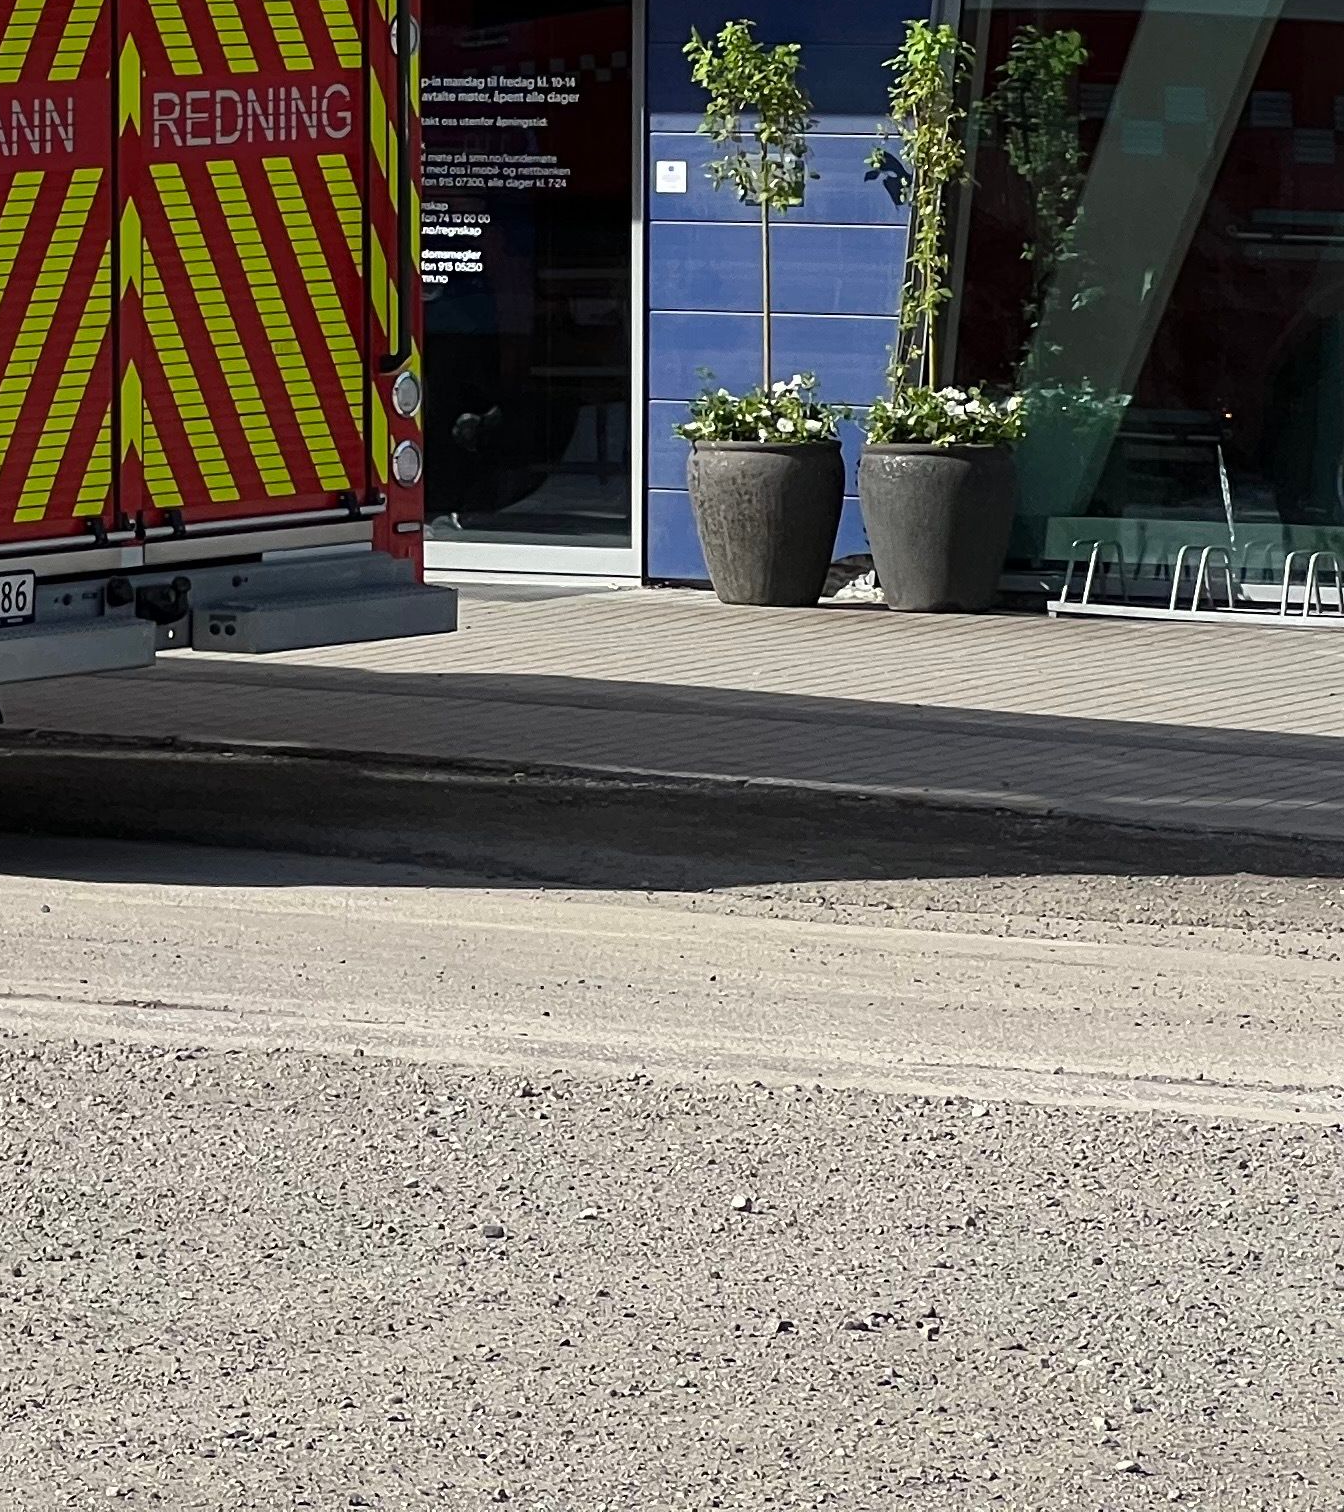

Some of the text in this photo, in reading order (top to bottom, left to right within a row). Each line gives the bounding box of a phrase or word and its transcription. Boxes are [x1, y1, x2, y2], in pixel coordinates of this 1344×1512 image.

[443, 76, 485, 90] mandag
[487, 76, 498, 87] til
[500, 76, 535, 90] fredag
[537, 76, 549, 87] kl.
[551, 77, 576, 87] 10-14
[458, 92, 492, 103] møter,
[494, 90, 524, 104] åpent
[526, 91, 545, 102] alle
[547, 92, 580, 105] dager
[153, 83, 353, 148] REDNING
[441, 118, 458, 126] oss
[459, 116, 495, 126] utenfor
[502, 167, 517, 178] og
[518, 166, 571, 176] nettbanken
[506, 178, 535, 190] dager
